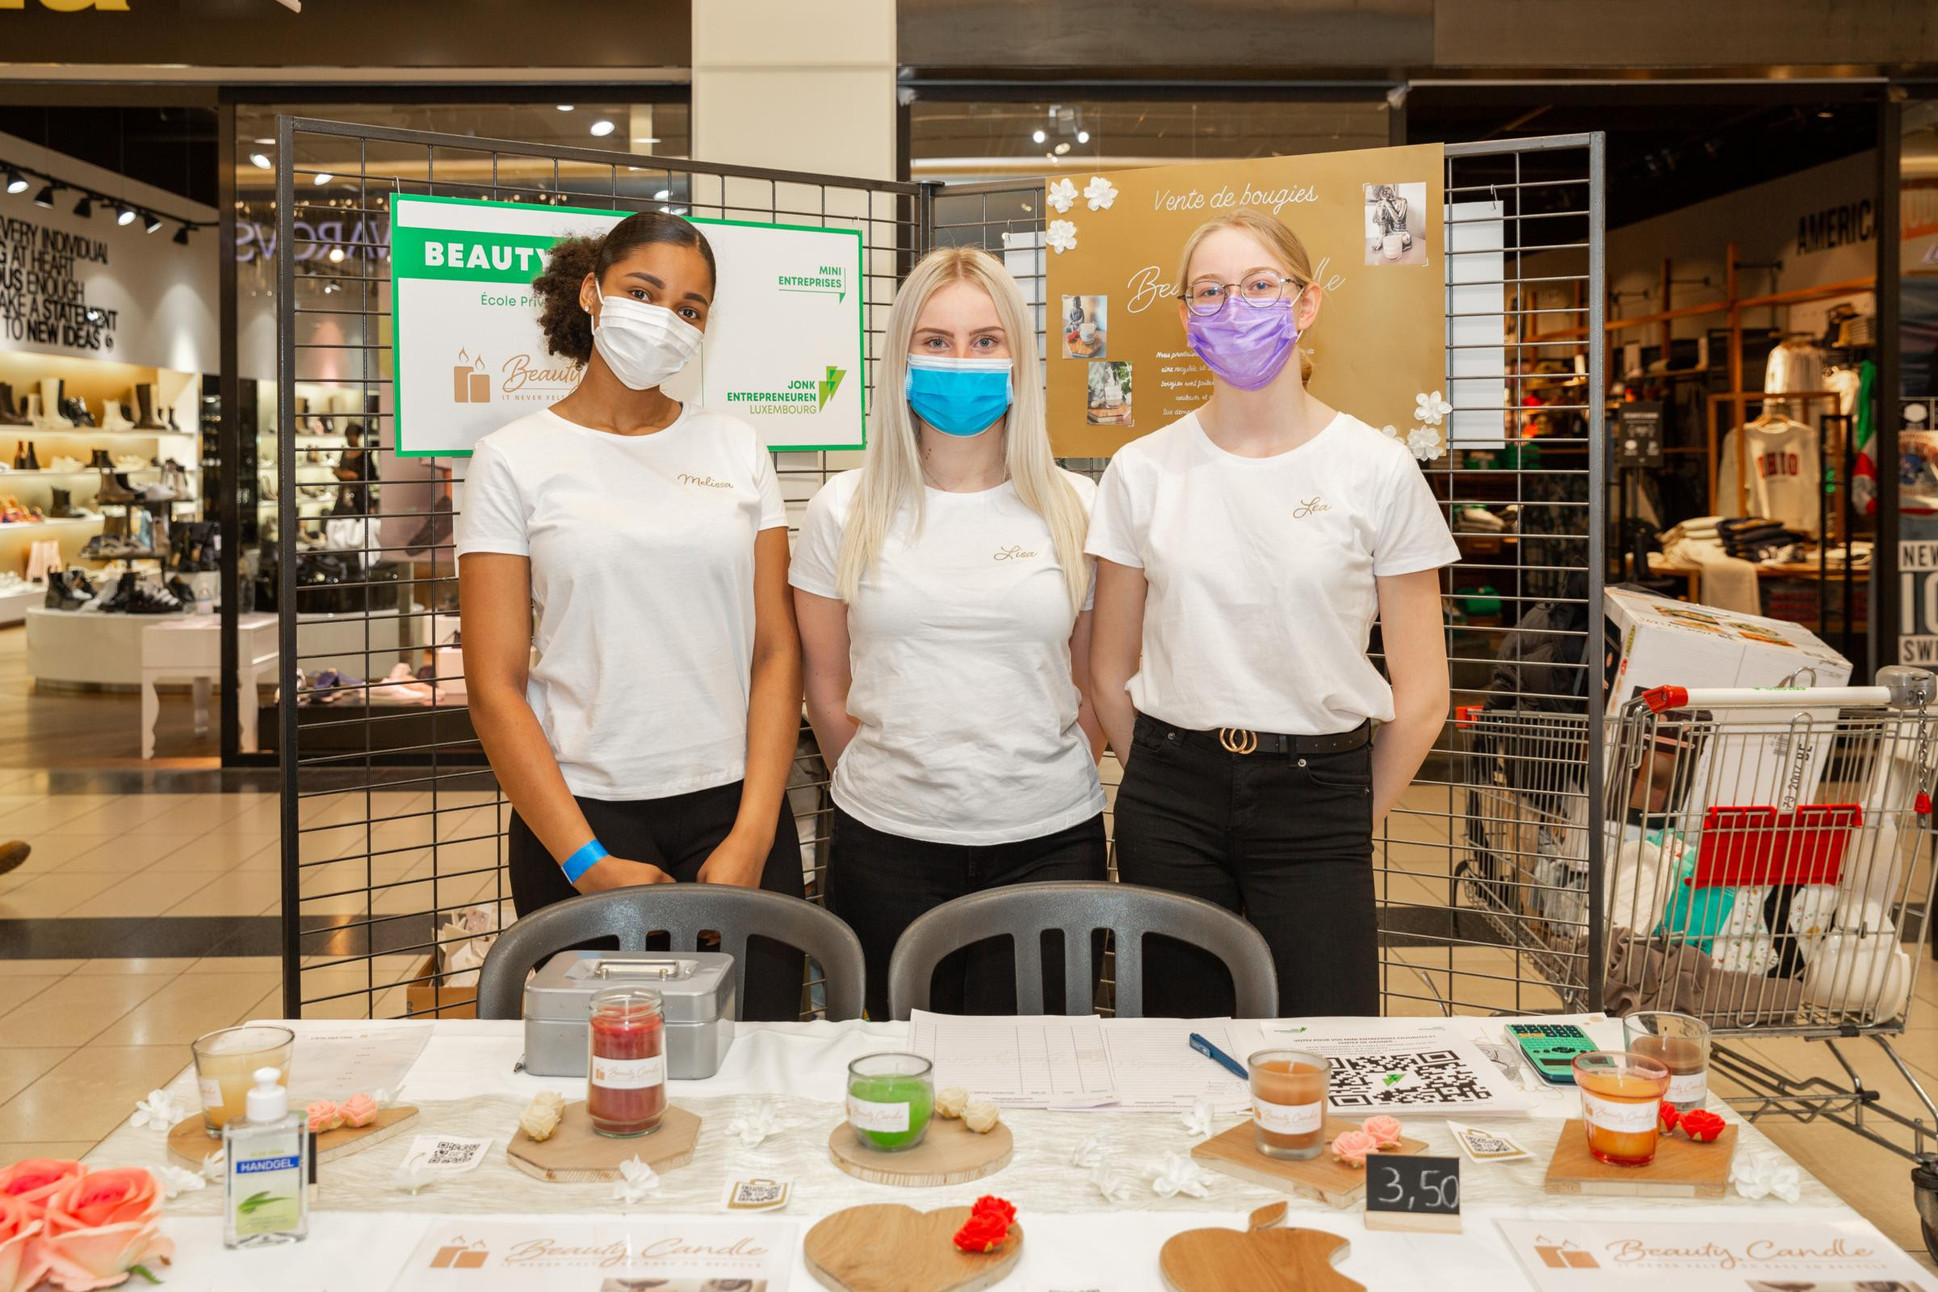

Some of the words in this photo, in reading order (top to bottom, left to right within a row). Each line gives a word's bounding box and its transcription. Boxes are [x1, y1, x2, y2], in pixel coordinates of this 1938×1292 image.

[1154, 189, 1205, 211] Vente
[1210, 185, 1235, 208] de
[1239, 183, 1319, 215] bougies
[819, 266, 842, 276] MINI
[778, 276, 842, 288] ENTREPRISES
[480, 292, 517, 307] École
[27, 320, 58, 344] NEW
[63, 325, 101, 350] IDEAS
[502, 354, 581, 393] Beauty
[787, 380, 816, 390] JONK
[727, 392, 817, 402] ENTREPRENEUREN
[750, 404, 817, 415] LUXEMBOURG
[677, 473, 734, 489] Melissa
[993, 545, 1038, 561] Lisa
[241, 1158, 294, 1172] HANDGEL
[1378, 1166, 1458, 1210] 3,50
[505, 1237, 629, 1268] Beauty
[641, 1237, 769, 1257] Candle
[1605, 1239, 1743, 1270] Beauty
[1746, 1238, 1876, 1262] Candle
